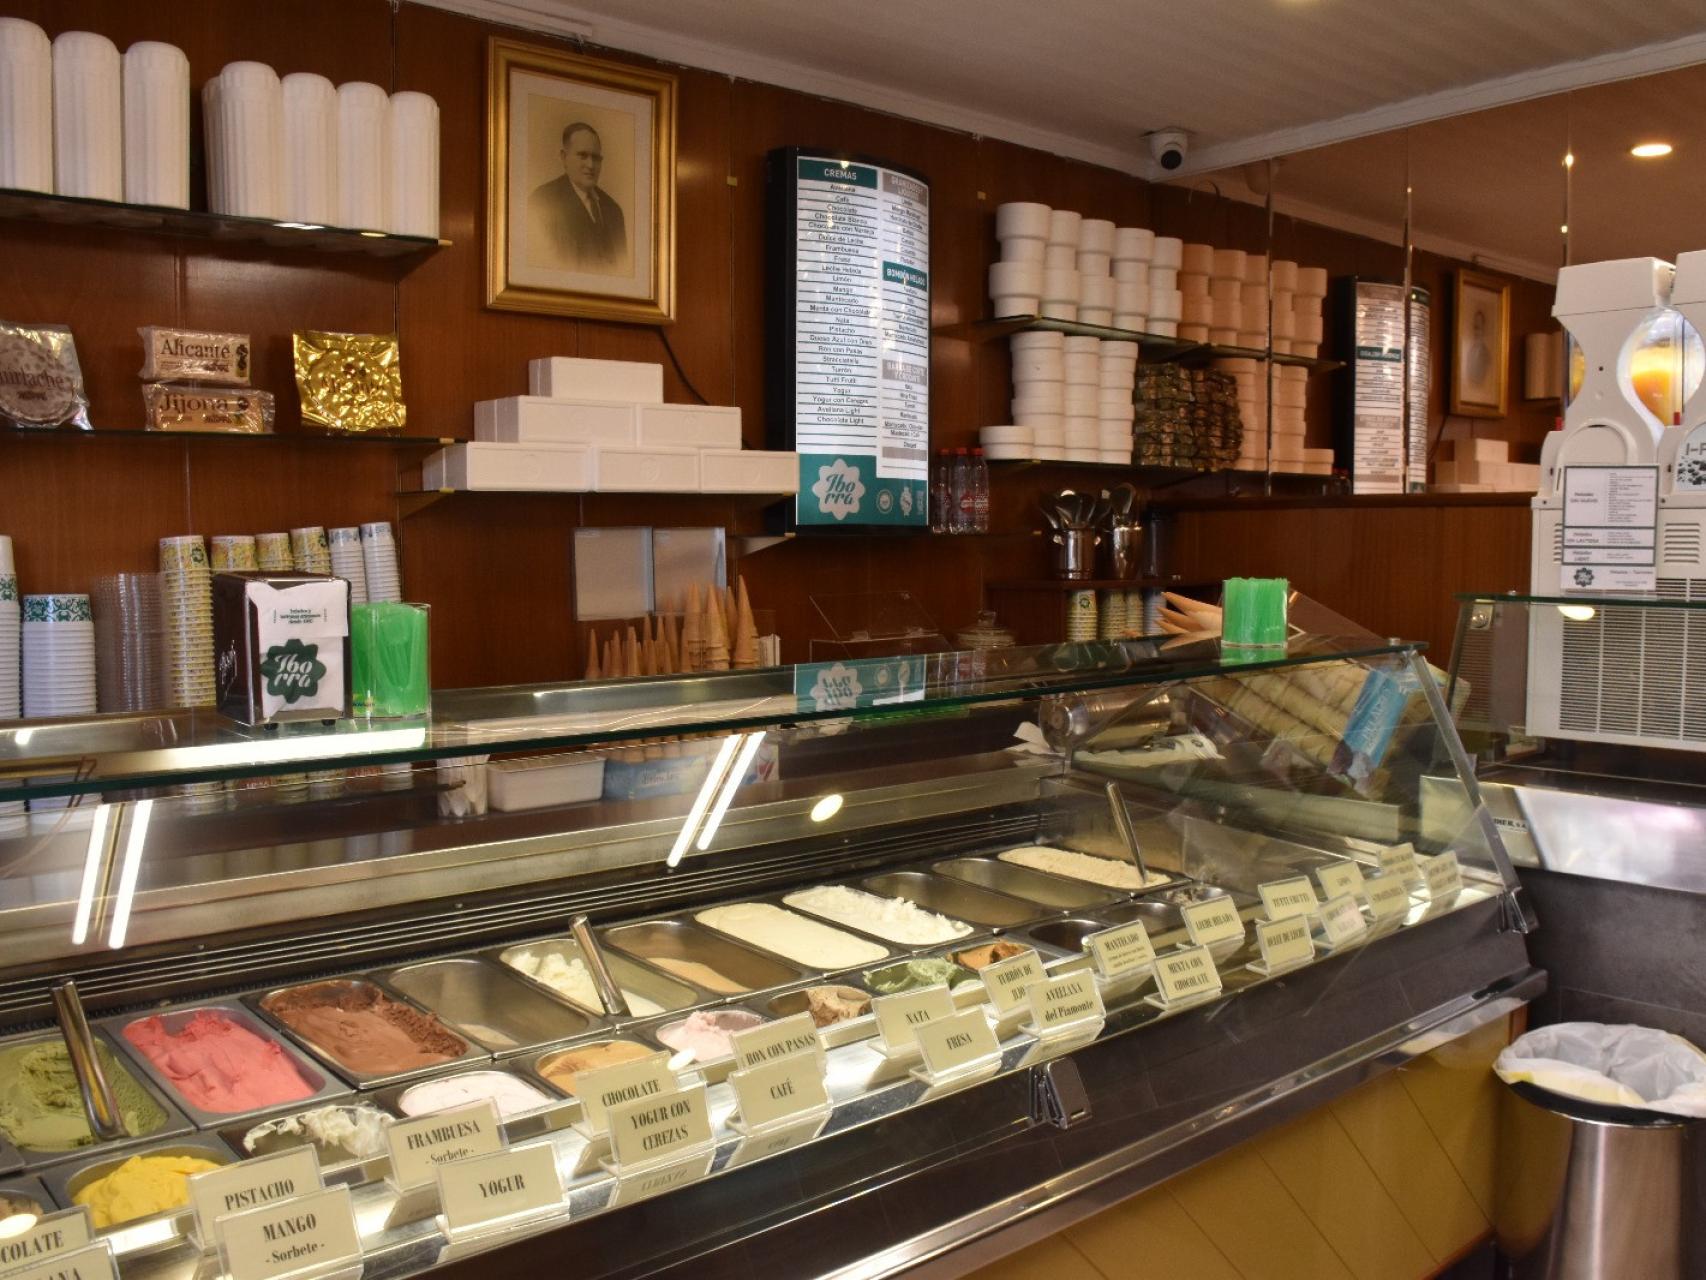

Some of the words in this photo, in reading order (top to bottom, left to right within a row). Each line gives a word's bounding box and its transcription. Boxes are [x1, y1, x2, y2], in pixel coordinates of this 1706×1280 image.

[824, 168, 857, 181] CREMAS
[825, 244, 860, 254] Frambuesa
[832, 286, 853, 295] Mango
[829, 326, 856, 334] Pistacho
[160, 338, 231, 360] Alicante
[812, 396, 832, 405] Yogur
[832, 387, 851, 396] Yogur
[159, 393, 228, 415] Jijona
[1167, 958, 1190, 975] MENTA
[1190, 956, 1205, 970] CON
[996, 968, 1022, 986] TURRÓN
[1174, 972, 1211, 992] CHOCOLATE
[1011, 986, 1026, 1001] JIJO
[1045, 982, 1084, 1002] AVELLANA
[906, 1008, 930, 1026] NATA
[1045, 1009, 1057, 1022] del
[1058, 1000, 1094, 1018] Piamonte
[745, 1048, 766, 1066] RON
[766, 1041, 786, 1060] CON
[785, 1032, 816, 1054] PASAS
[946, 1031, 973, 1052] FRESA
[602, 1078, 662, 1108] CHOCOLATE
[770, 1077, 794, 1100] CAFÉ
[630, 1106, 669, 1130] YOGUR
[670, 1099, 692, 1118] CON
[406, 1119, 481, 1150] FRAMBUESA
[642, 1124, 690, 1152] CEREZAS
[224, 1178, 296, 1212] PISTACHO
[478, 1174, 526, 1199] YOGUR
[262, 1212, 318, 1243] MANGO
[0, 1230, 65, 1264] COLATE
[271, 1242, 320, 1265] Sorbete
